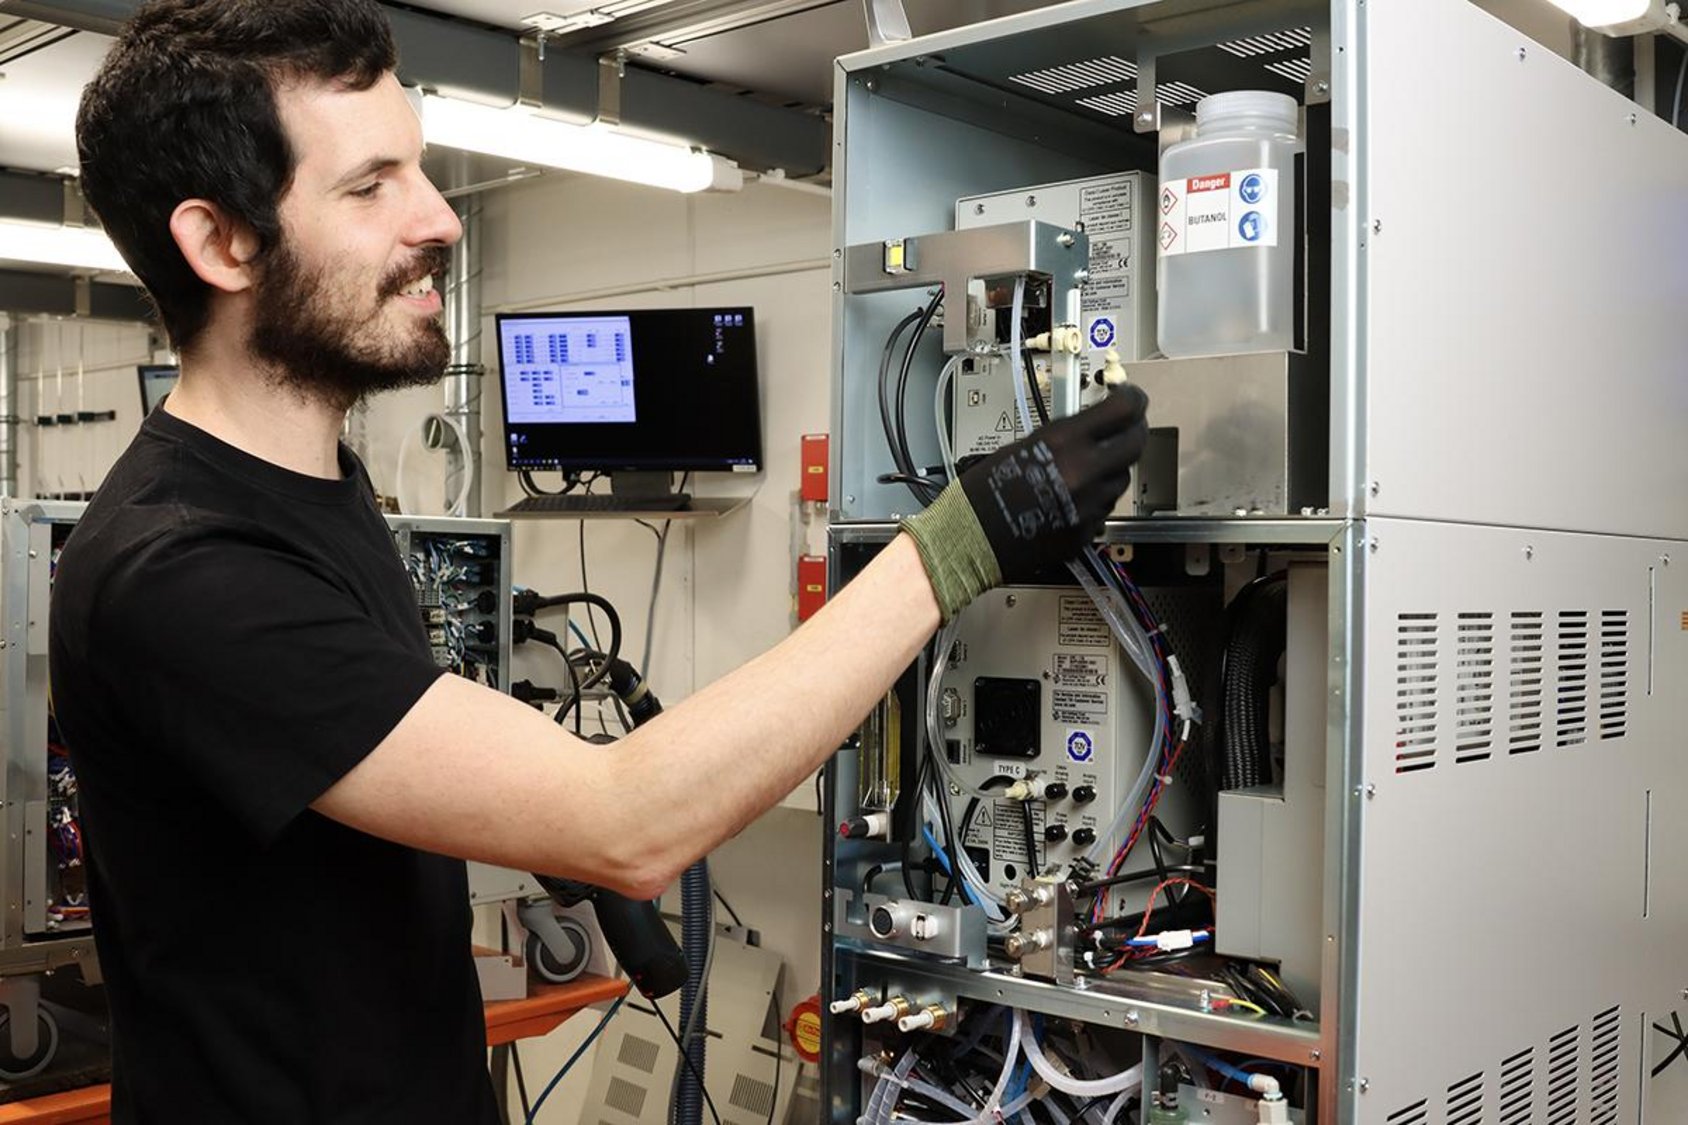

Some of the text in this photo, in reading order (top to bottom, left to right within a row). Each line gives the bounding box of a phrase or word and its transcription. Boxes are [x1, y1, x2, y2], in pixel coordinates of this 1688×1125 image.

[1192, 177, 1226, 190] Danger
[1188, 212, 1227, 225] BUTANOL
[998, 764, 1013, 773] TYPE
[1015, 766, 1020, 775] C
